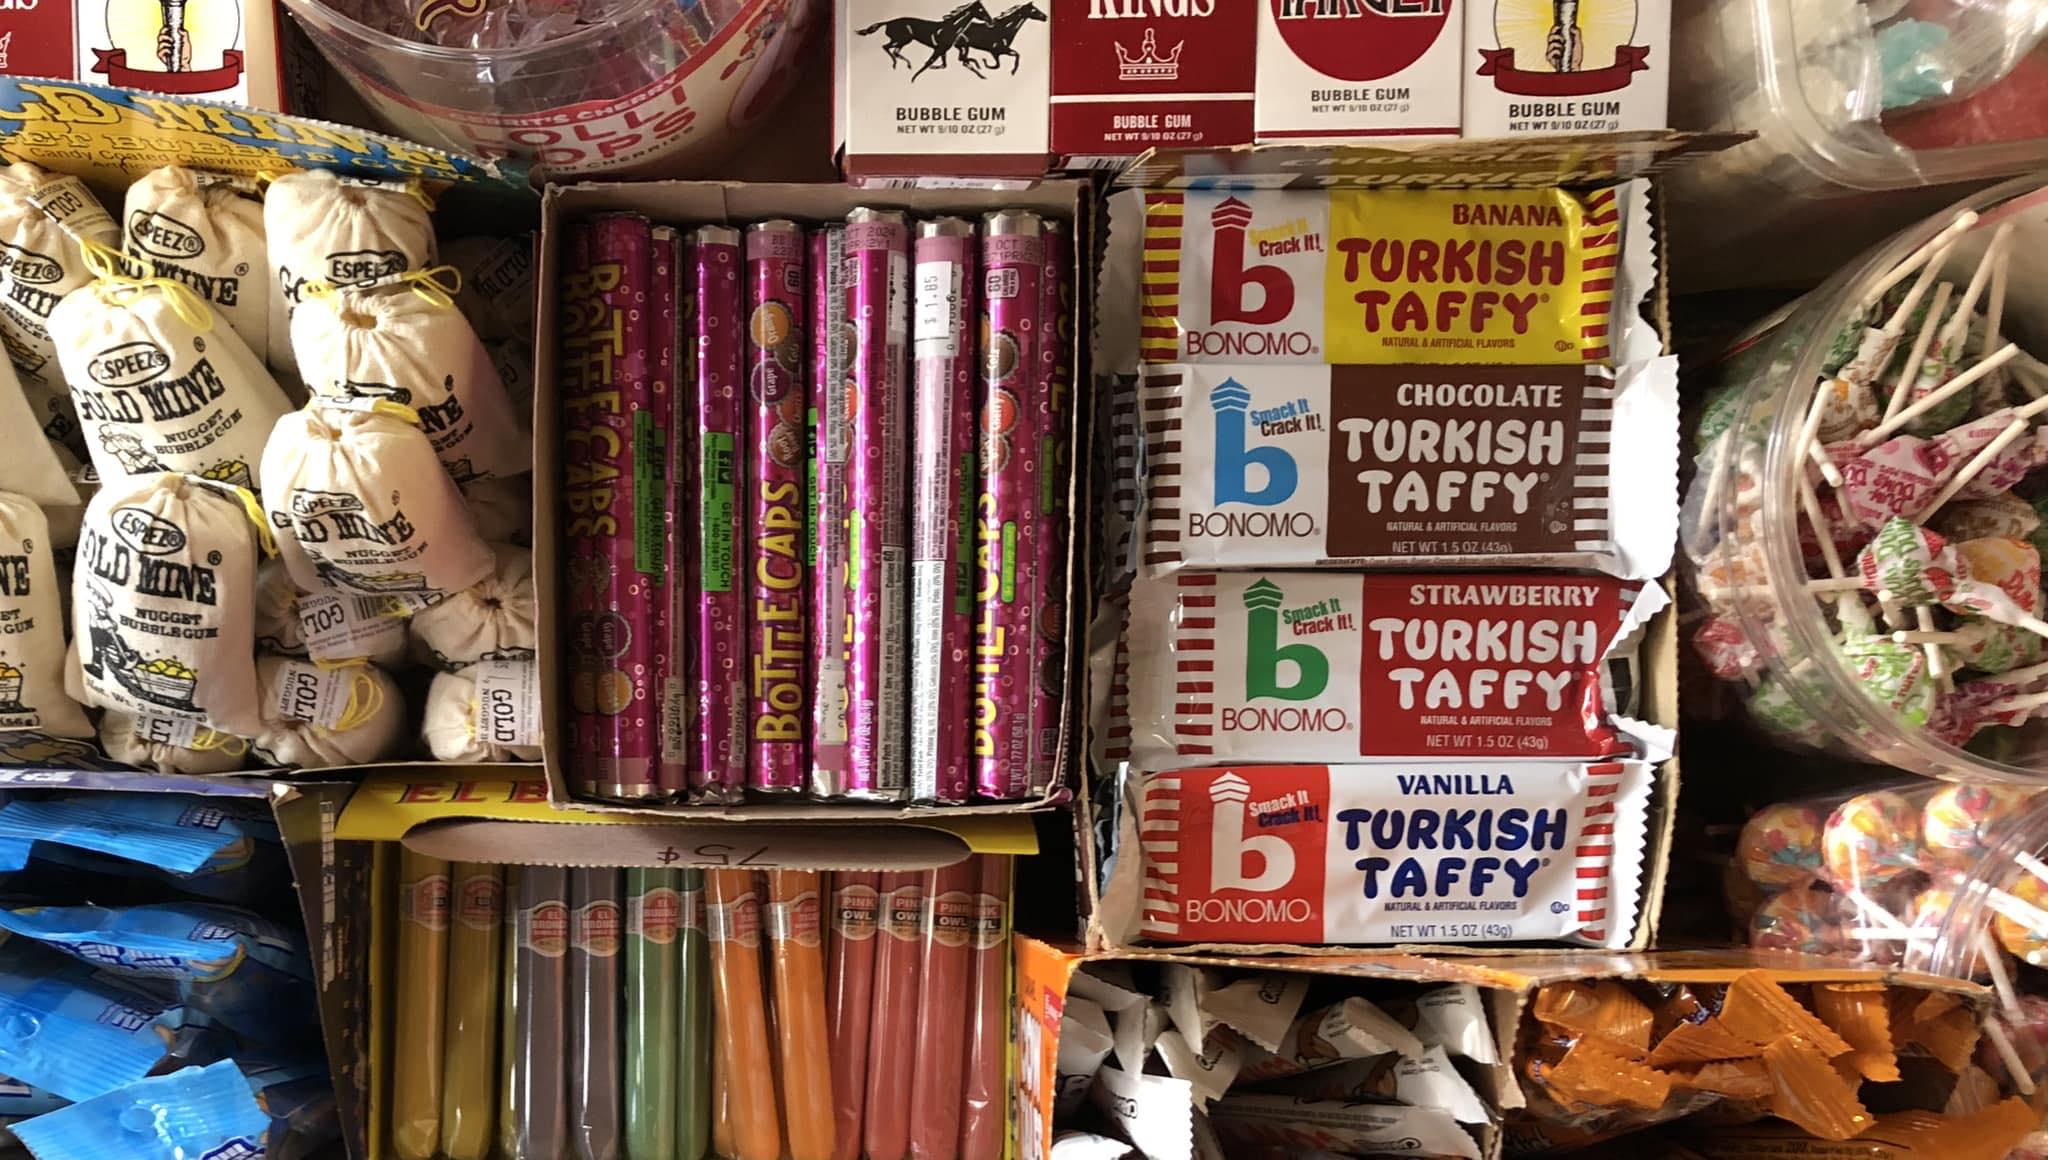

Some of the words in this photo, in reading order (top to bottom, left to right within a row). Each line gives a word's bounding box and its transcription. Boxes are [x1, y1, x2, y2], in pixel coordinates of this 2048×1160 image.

[577, 74, 679, 121] CHERRY
[1311, 89, 1371, 102] BUBBLE
[1375, 88, 1410, 101] GUM
[896, 107, 962, 121] BUBBLE
[967, 107, 1005, 121] GUM
[1312, 104, 1329, 113] NET
[1332, 104, 1346, 113] WT
[1509, 102, 1576, 118] BUBBLE
[1581, 102, 1620, 117] GUM
[897, 125, 917, 134] NET
[919, 125, 935, 134] WT
[1113, 115, 1158, 129] BUBBLE
[1165, 115, 1191, 128] GUM
[1510, 120, 1528, 131] NET
[1531, 120, 1547, 131] WT
[1104, 132, 1123, 141] NET
[1125, 132, 1140, 141] WT
[31, 148, 92, 162] Candy
[1453, 204, 1562, 226] BANANA
[1258, 239, 1300, 257] Crack
[1336, 238, 1566, 286] TURKISH
[8, 278, 63, 318] MIN
[924, 275, 938, 308] 1.85
[1354, 290, 1539, 334] TAFFY
[1187, 331, 1311, 356] BONOMO
[1382, 337, 1422, 349] NATURAL
[1431, 338, 1474, 348] ARTIFICIAL
[1476, 338, 1515, 349] FLAVORS
[71, 385, 143, 423] GOLD
[141, 357, 226, 421] MINE
[766, 368, 778, 396] Grape
[1397, 383, 1562, 408] CHOCOLATE
[164, 409, 224, 443] NUGGET
[1251, 404, 1296, 427] Smack
[1260, 418, 1303, 437] Crack
[1337, 418, 1564, 465] TURKISH
[1356, 470, 1538, 514] TAFFY
[721, 502, 731, 523] GET
[330, 513, 414, 545] MINE
[721, 530, 731, 542] IN
[757, 480, 801, 591] CAPS
[1189, 512, 1314, 538] BONOMO
[1386, 521, 1425, 532] NATURAL
[1435, 521, 1477, 532] ARTIFICIAL
[1479, 522, 1518, 532] FLAVORS
[346, 547, 411, 559] NUGGET
[884, 550, 895, 562] 60
[1392, 541, 1416, 553] NET
[1418, 541, 1438, 553] WT
[1462, 541, 1479, 553] OZ
[720, 546, 731, 587] TOUCH
[885, 563, 895, 588] Calories
[136, 554, 216, 606] MINE
[1409, 584, 1600, 607] STRAWBERRY
[135, 608, 202, 625] NUGGET
[303, 605, 344, 638] GOL
[1283, 602, 1328, 624] Smack
[1293, 619, 1335, 636] Crack
[1369, 618, 1597, 665] TURKISH
[1388, 668, 1571, 711] TAFFY
[491, 688, 516, 743] GOLD
[1222, 707, 1347, 732] BONOMO
[1420, 716, 1459, 726] NATURAL
[1469, 716, 1513, 726] ARTIFICIAL
[1515, 716, 1552, 727] FLAVORS
[1427, 735, 1451, 749] NET
[1453, 735, 1473, 748] WT
[1476, 735, 1495, 748] 1.5
[1497, 735, 1515, 748] OZ
[1517, 735, 1548, 750] (43g)
[397, 782, 487, 804] EL
[1396, 774, 1514, 796] VANILLA
[1249, 797, 1296, 816] Smack
[1257, 811, 1300, 829] Crack
[1336, 808, 1567, 851] TURKISH
[1355, 857, 1539, 899] TAFFY
[842, 896, 875, 907] PINK
[896, 896, 921, 907] PIN
[940, 903, 970, 914] PINK
[1187, 899, 1311, 923] BONOMO
[1384, 901, 1424, 913] NATURAL
[1433, 901, 1477, 912] ARTIFICIAL
[1478, 900, 1517, 911] FLAVORS
[842, 909, 873, 921] OWL
[939, 915, 970, 927] OWL
[1391, 925, 1416, 938] NET
[1418, 925, 1438, 937] WT
[1441, 924, 1460, 937] 1.5
[1462, 924, 1479, 937] OZ
[1481, 924, 1513, 939] (43g)
